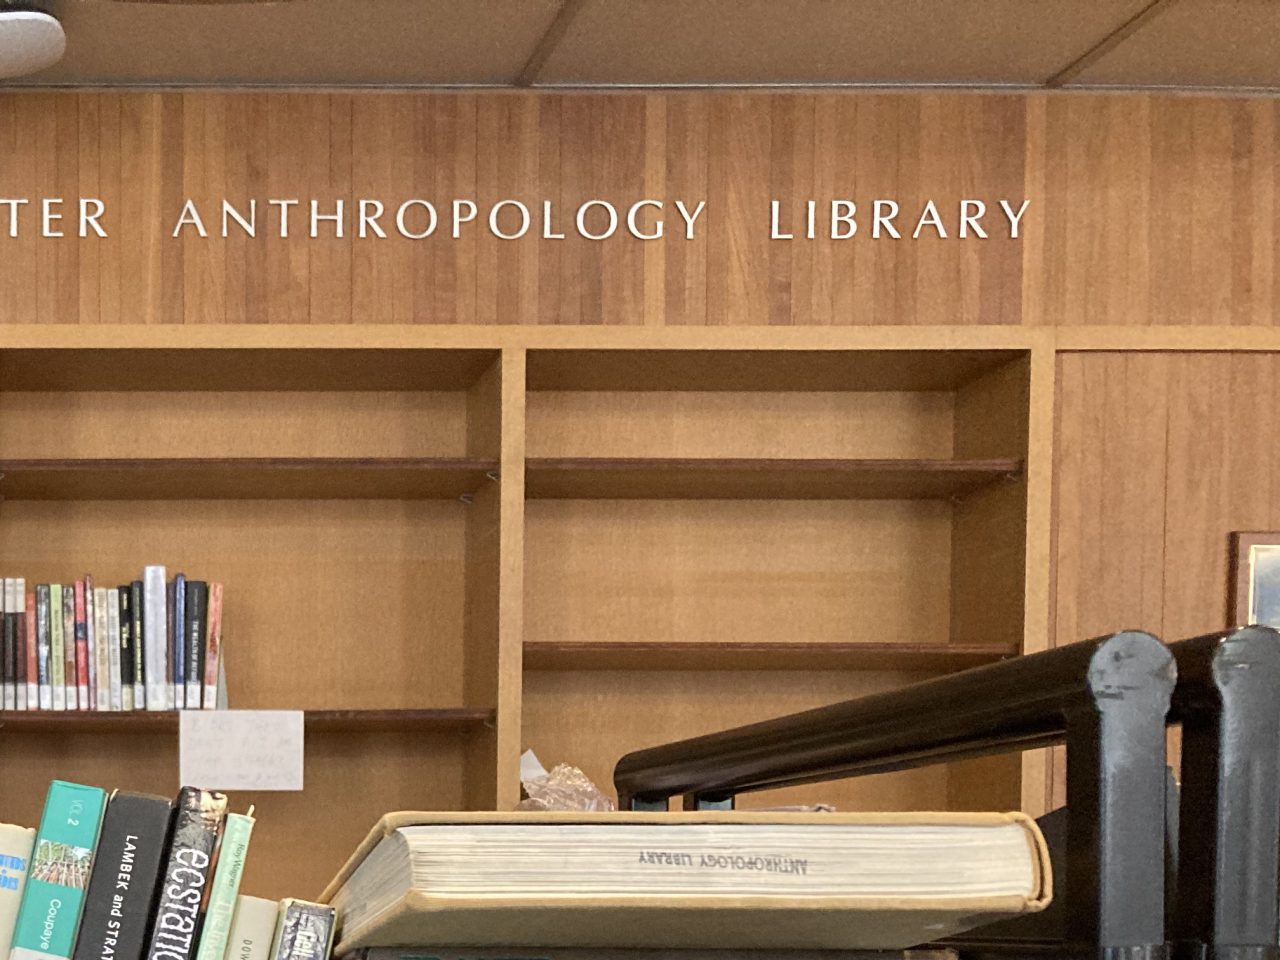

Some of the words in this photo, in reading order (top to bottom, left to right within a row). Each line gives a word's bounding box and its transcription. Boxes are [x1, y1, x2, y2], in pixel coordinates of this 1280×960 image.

[172, 198, 707, 241] ANTHROPOLOGY
[771, 199, 1033, 241] LIBRARY
[114, 834, 139, 891] LAMBEK
[40, 898, 63, 951] Coupaye
[108, 892, 125, 917] and
